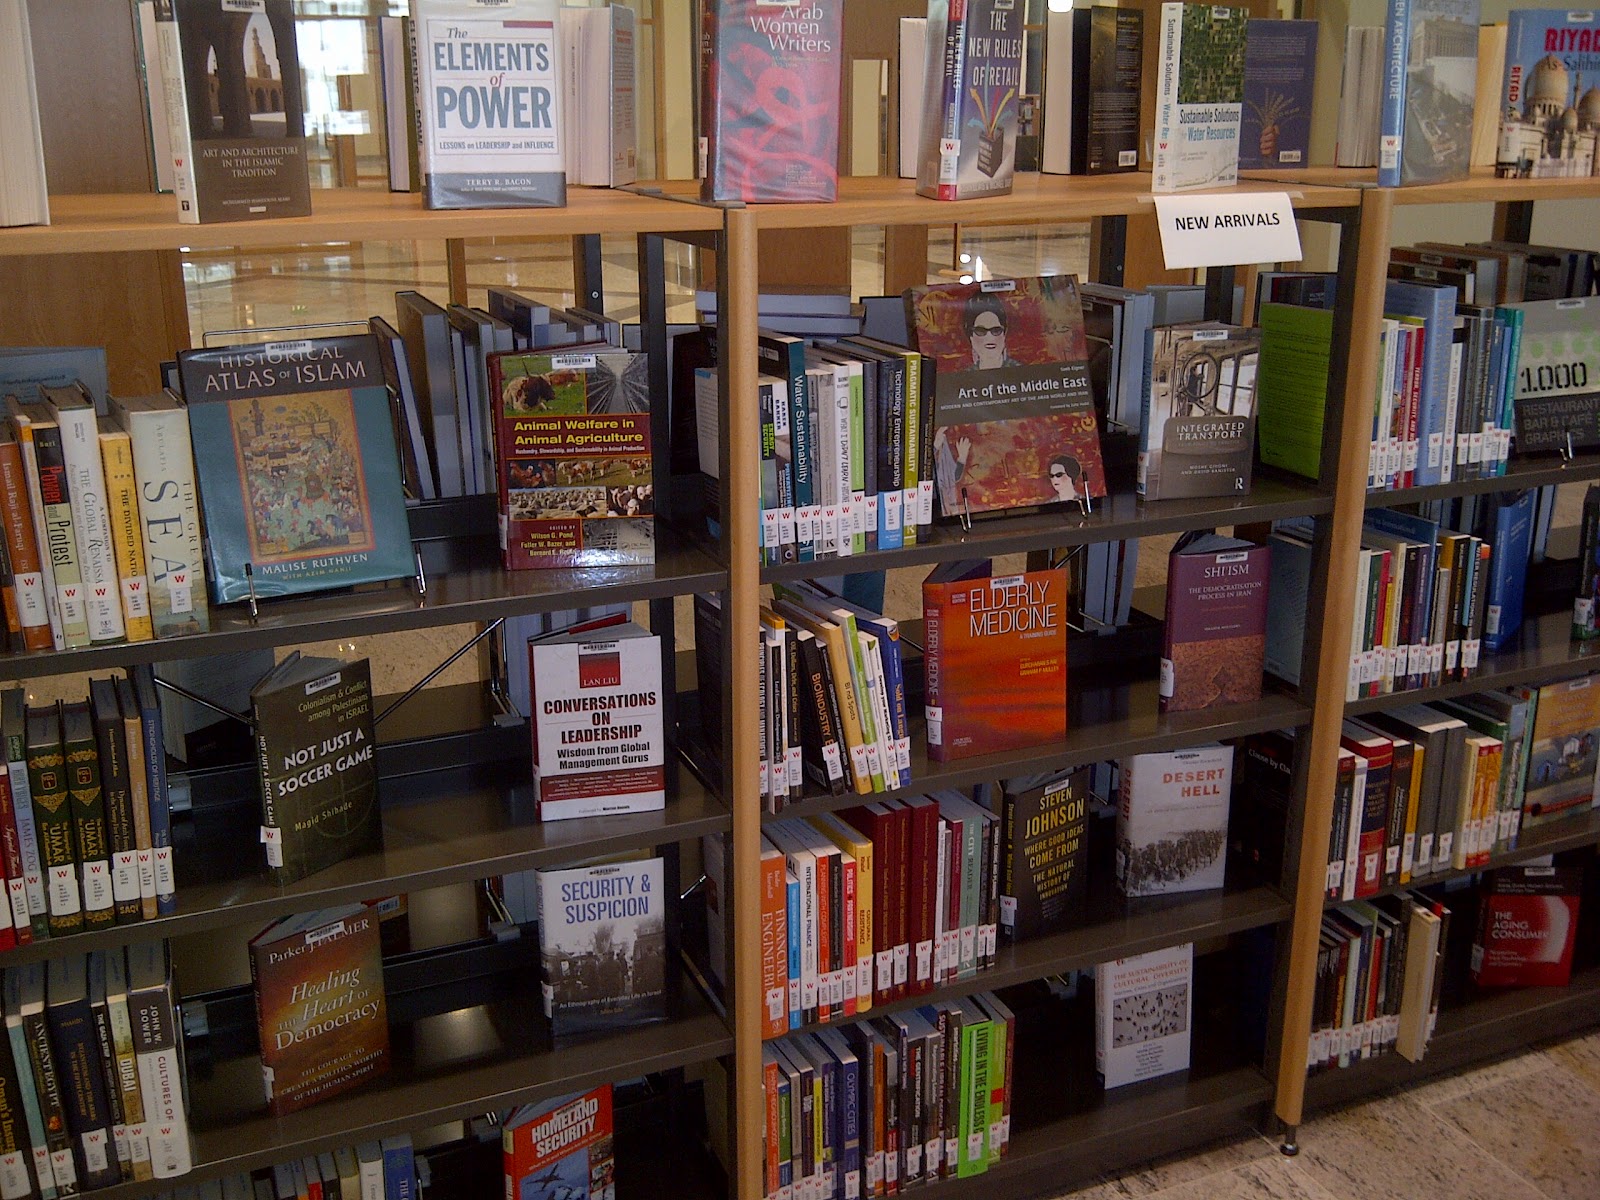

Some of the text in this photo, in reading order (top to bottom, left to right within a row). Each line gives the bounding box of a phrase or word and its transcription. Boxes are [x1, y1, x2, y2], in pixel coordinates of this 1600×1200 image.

[781, 3, 823, 20] Arab
[990, 11, 1007, 31] THE
[447, 28, 468, 39] The
[750, 16, 819, 34] Women
[769, 34, 831, 52] Writers
[969, 37, 1022, 58] NEW RULES
[434, 43, 549, 72] ELEMENTS
[946, 49, 954, 76] RETAIL
[1164, 18, 1176, 96] Sustainable Solutions
[1389, 20, 1404, 100] ARCHITECTURE
[490, 72, 505, 89] of
[973, 66, 1018, 85] OF RETAIL
[436, 86, 552, 129] POWER
[1180, 107, 1239, 124] Sustainable Solutions
[1187, 126, 1235, 141] Water Resources
[203, 146, 298, 157] ART AND ARCHITECTURE
[439, 142, 466, 150] LESSONS
[523, 141, 554, 149] INFLUENCE
[222, 157, 283, 167] IN THE ISLAMIC
[232, 168, 277, 178] TRADITION
[1175, 212, 1280, 231] NEW ARRIVALS
[219, 346, 344, 370] HISTORICAL
[205, 360, 367, 393] ATLAS ISLAM
[958, 376, 1087, 399] Art of the Middle East
[908, 360, 917, 472] PRAGMATIC SUSTAINABILITY
[1522, 398, 1599, 414] RESTAURANT
[514, 419, 635, 431] Animal Welfare in
[794, 376, 807, 484] Water Sustainability
[892, 370, 902, 487] Technology Entrepreneurship
[1176, 422, 1245, 433] INTEGRATED
[1178, 430, 1242, 441] TRANSPORT
[1524, 418, 1549, 430] BAR
[515, 432, 643, 445] Animal Agriculture
[2, 462, 17, 490] Ismail
[79, 468, 99, 535] THE GLOBAL
[183, 480, 193, 514] THE
[40, 465, 73, 567] Power Protest
[121, 488, 134, 547] THE DIVIDED
[100, 514, 110, 551] COMPANION
[143, 480, 187, 583] SEA
[262, 553, 369, 575] MALISE RUTHVEN
[1204, 564, 1249, 578] SHI'ISM
[23, 578, 34, 586] W
[129, 583, 140, 591] W
[174, 575, 185, 583] W
[1203, 581, 1262, 593] DEMOCRATISATION
[65, 588, 76, 597] W
[95, 588, 105, 596] W
[970, 580, 1050, 613] ELDERLY
[970, 604, 1057, 637] MEDICINE
[583, 677, 617, 686] LAN LIU
[298, 680, 367, 713] Colonialism Conflict
[308, 693, 368, 722] among Palestinians
[544, 691, 656, 714] CONVERSATIONS
[811, 673, 831, 736] BIOINDUSTRY
[346, 704, 369, 719] ISRAEL
[592, 711, 610, 726] ON
[848, 701, 856, 721] Spots
[561, 724, 642, 744] LEADERSHIP
[284, 727, 365, 771] NOT JUST A
[557, 742, 650, 759] Wisdom from Global
[278, 744, 374, 797] SOCCER GAME
[559, 754, 649, 770] Management Gurus
[1162, 768, 1225, 784] DESERT
[1039, 787, 1072, 811] STEVEN
[1181, 785, 1220, 797] HELL
[294, 801, 353, 832] Magid Shibade
[1024, 798, 1085, 839] JOHNSON
[20, 818, 34, 848] JAMES
[266, 831, 274, 839] W
[1024, 825, 1084, 857] WHERE GOOD IDEAS
[158, 852, 167, 860] W
[1029, 838, 1079, 869] COME FROM
[57, 870, 67, 878] W
[91, 866, 101, 874] W
[1033, 860, 1074, 884] THE NATURAL
[562, 874, 651, 902] SECURITY &
[565, 896, 649, 924] SUSPICION
[1494, 911, 1513, 920] THE
[1492, 920, 1529, 930] AGING
[1492, 929, 1551, 939] CONSUMER
[269, 945, 305, 964] Parker
[775, 909, 785, 982] FINANCIAL
[289, 967, 360, 1005] Healing
[302, 990, 353, 1021] Heart
[140, 1009, 151, 1044] DOWER
[149, 1005, 161, 1031] JOHN
[275, 999, 380, 1051] Democracy
[120, 1058, 137, 1091] DUBAI
[974, 1027, 988, 1127] LIVING THE ENDLESS
[45, 1073, 60, 1107] EGYPT
[158, 1056, 174, 1120] CULTURES OF
[846, 1073, 856, 1135] OLYMPIC CITIES
[531, 1098, 598, 1144] HOMELAND
[536, 1115, 596, 1158] SECURITY
